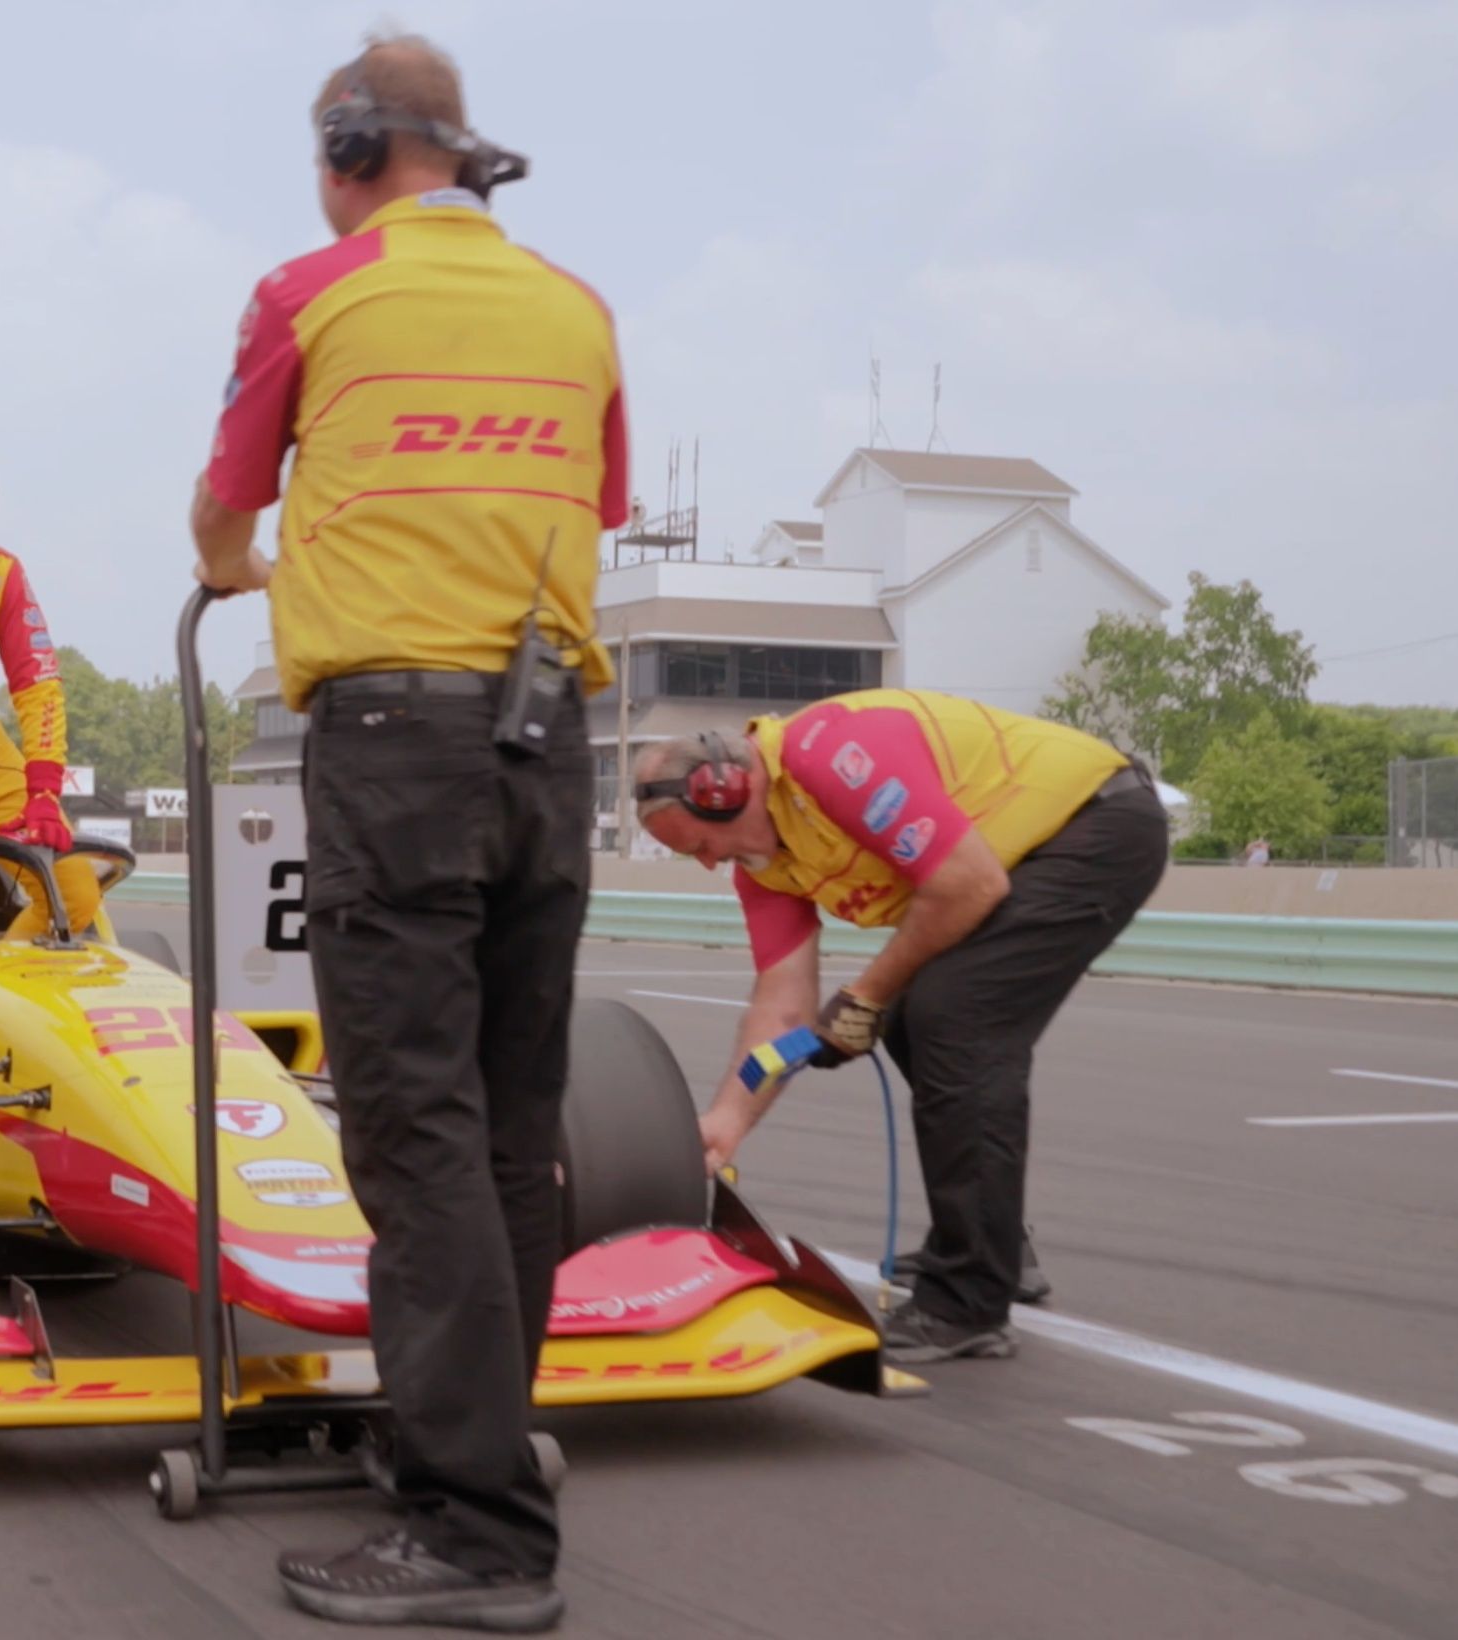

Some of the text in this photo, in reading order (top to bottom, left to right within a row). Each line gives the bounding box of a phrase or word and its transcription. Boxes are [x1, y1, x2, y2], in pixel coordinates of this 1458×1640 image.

[391, 414, 568, 459] DHL
[265, 860, 309, 951] 2
[1064, 1410, 1458, 1506] 26
